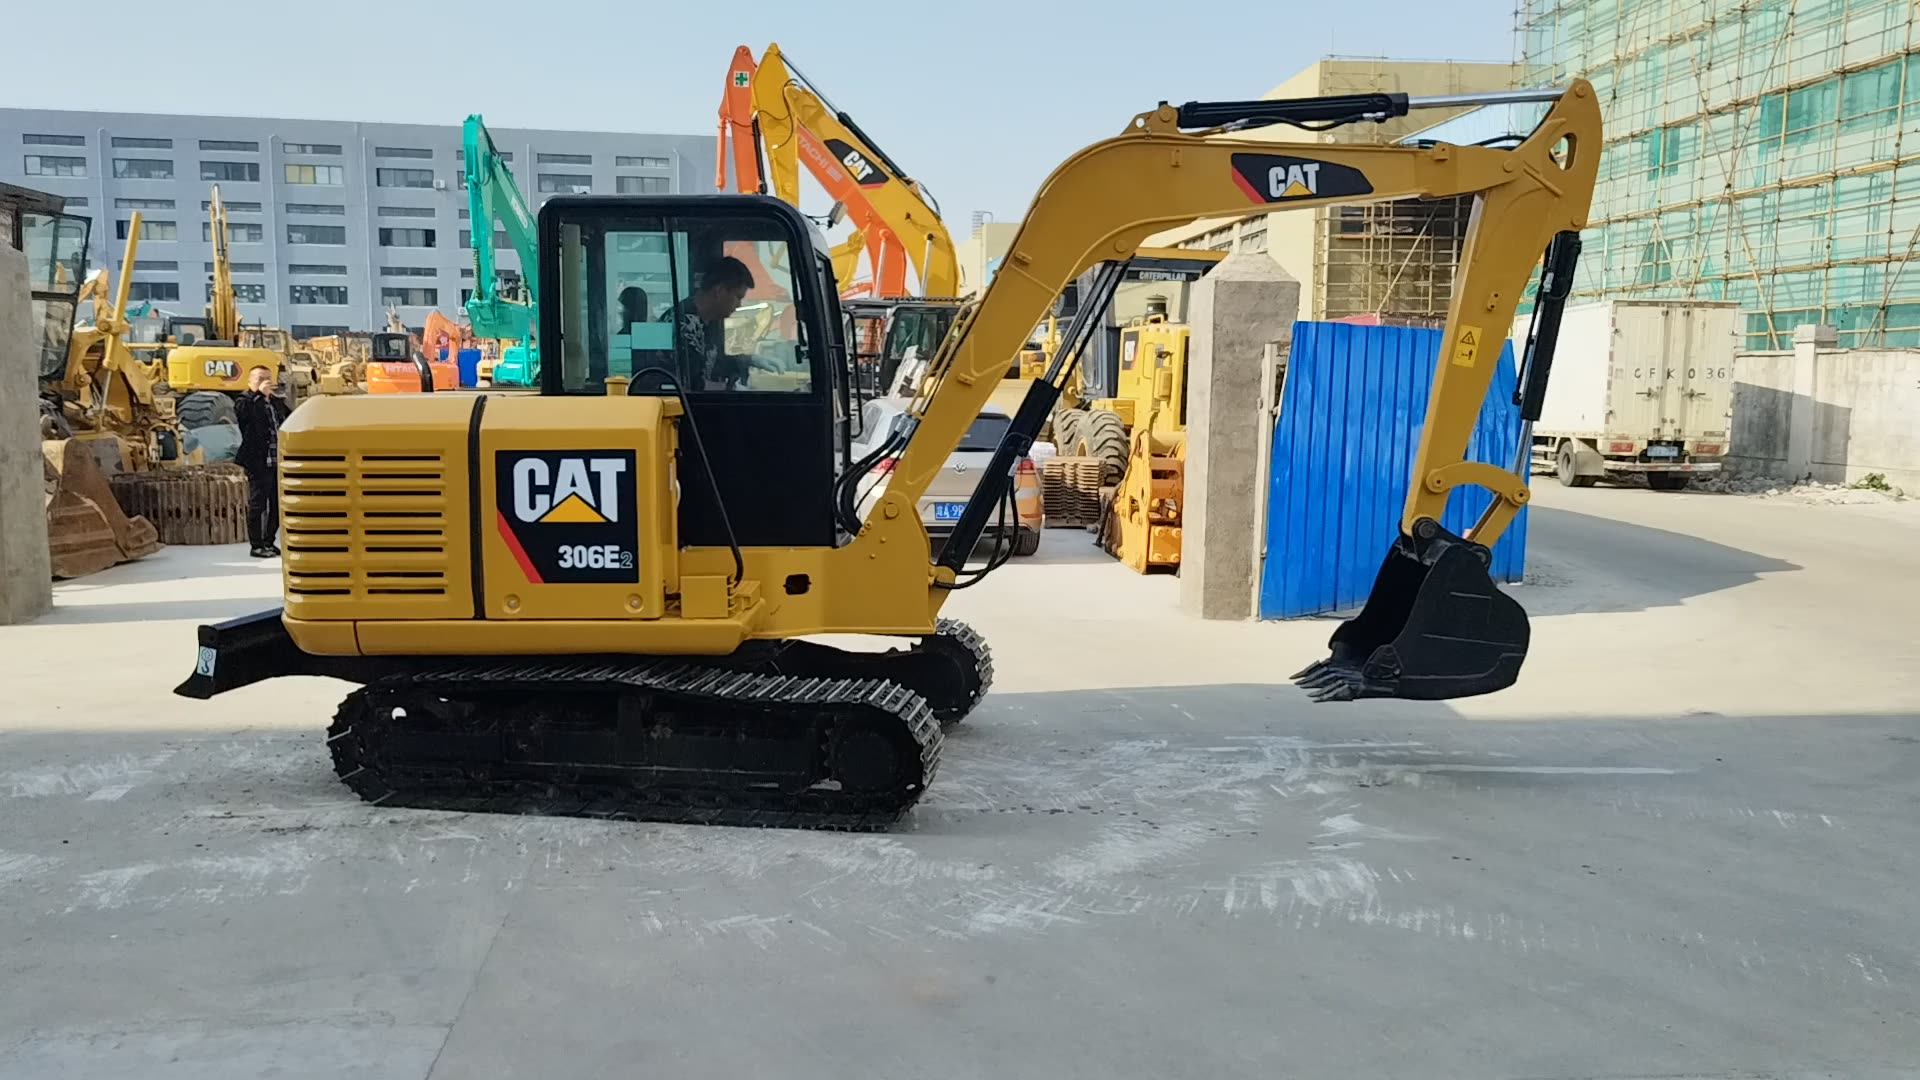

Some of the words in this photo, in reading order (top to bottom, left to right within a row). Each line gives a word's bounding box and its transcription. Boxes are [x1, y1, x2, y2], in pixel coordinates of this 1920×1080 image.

[843, 150, 874, 181] CAT
[1268, 162, 1320, 198] CAT
[1139, 271, 1187, 281] CATERPILLAR
[204, 360, 235, 377] CAT
[513, 457, 626, 523] CAT
[558, 544, 633, 569] 306E2
